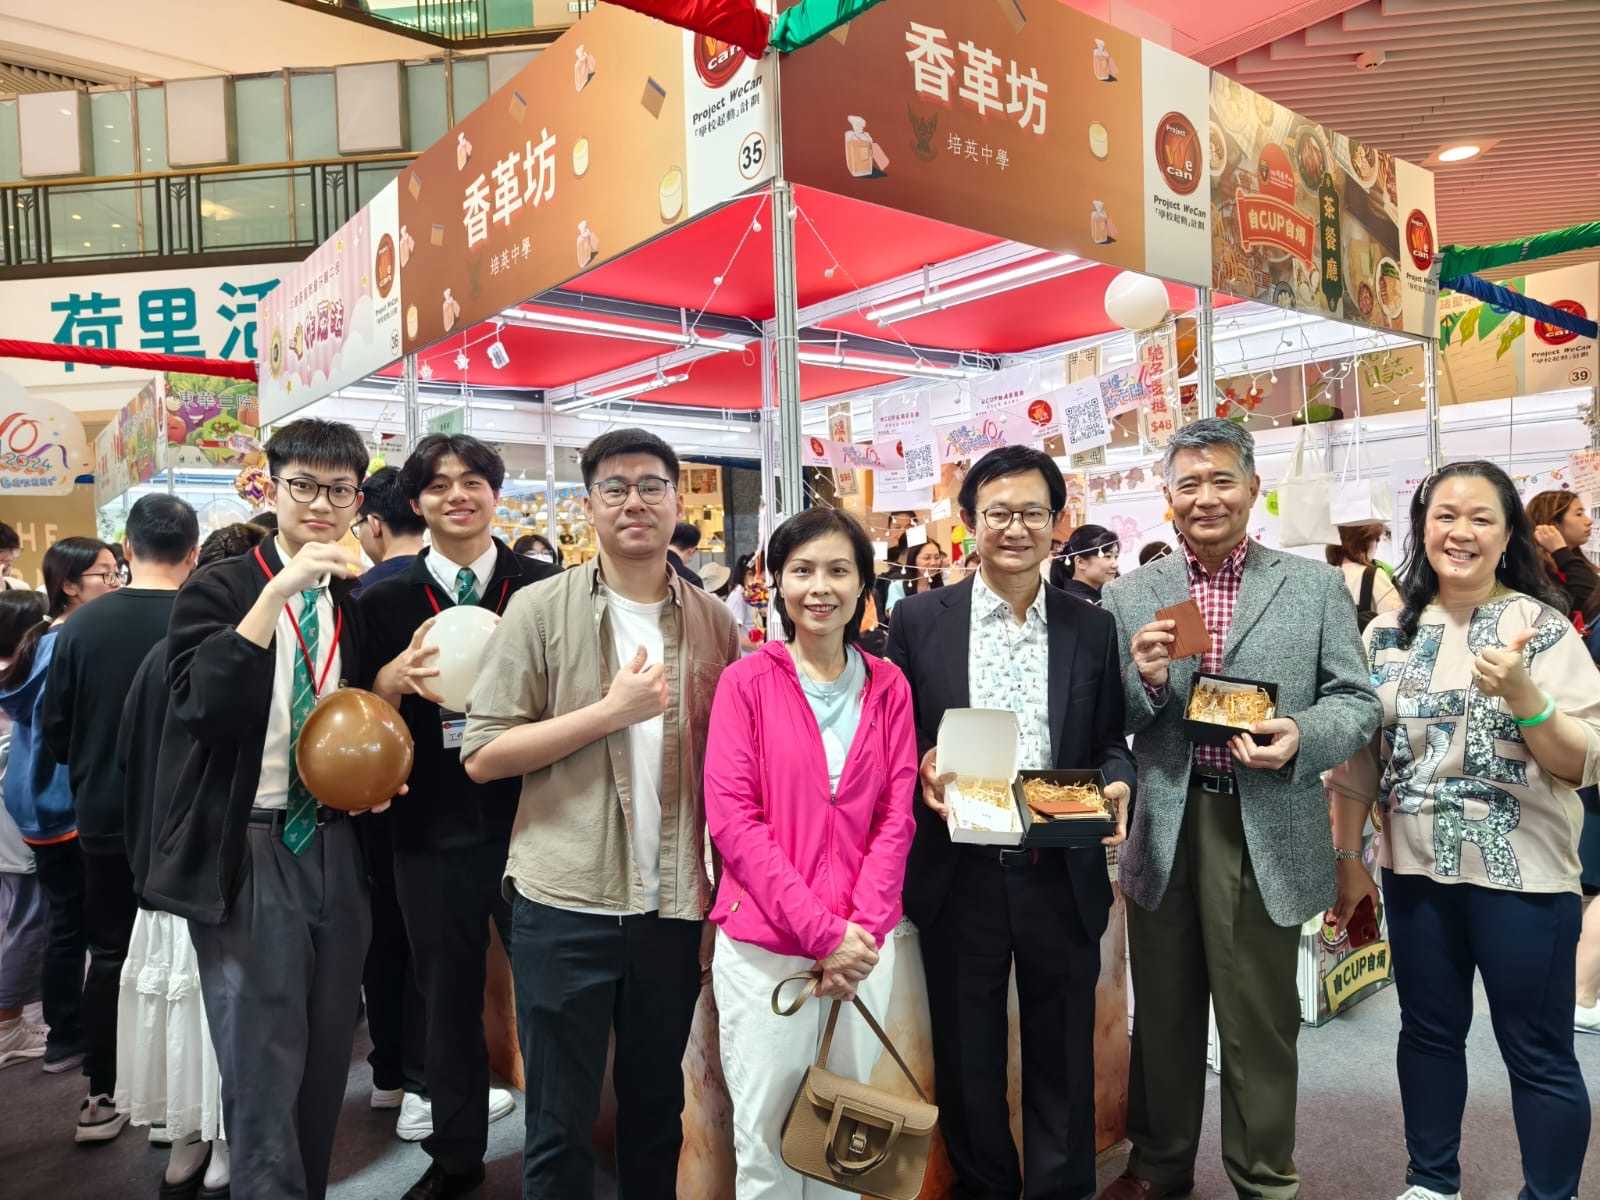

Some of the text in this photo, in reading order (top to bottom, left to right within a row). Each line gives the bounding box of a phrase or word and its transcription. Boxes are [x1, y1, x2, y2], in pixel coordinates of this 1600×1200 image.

[905, 21, 1049, 135] 香革坊
[692, 75, 763, 126] Project WeCan
[741, 138, 763, 170] 35
[947, 131, 1010, 171] 培英中學
[463, 127, 557, 248] 香革坊
[1166, 165, 1194, 181] can
[1153, 194, 1207, 219] Project WeCan
[490, 236, 532, 275] 培英中學
[51, 278, 281, 373] 荷里活
[1531, 344, 1592, 359] Project WeCan
[1571, 370, 1589, 382] 39
[1150, 420, 1173, 434] $48
[2, 451, 54, 471] 2024
